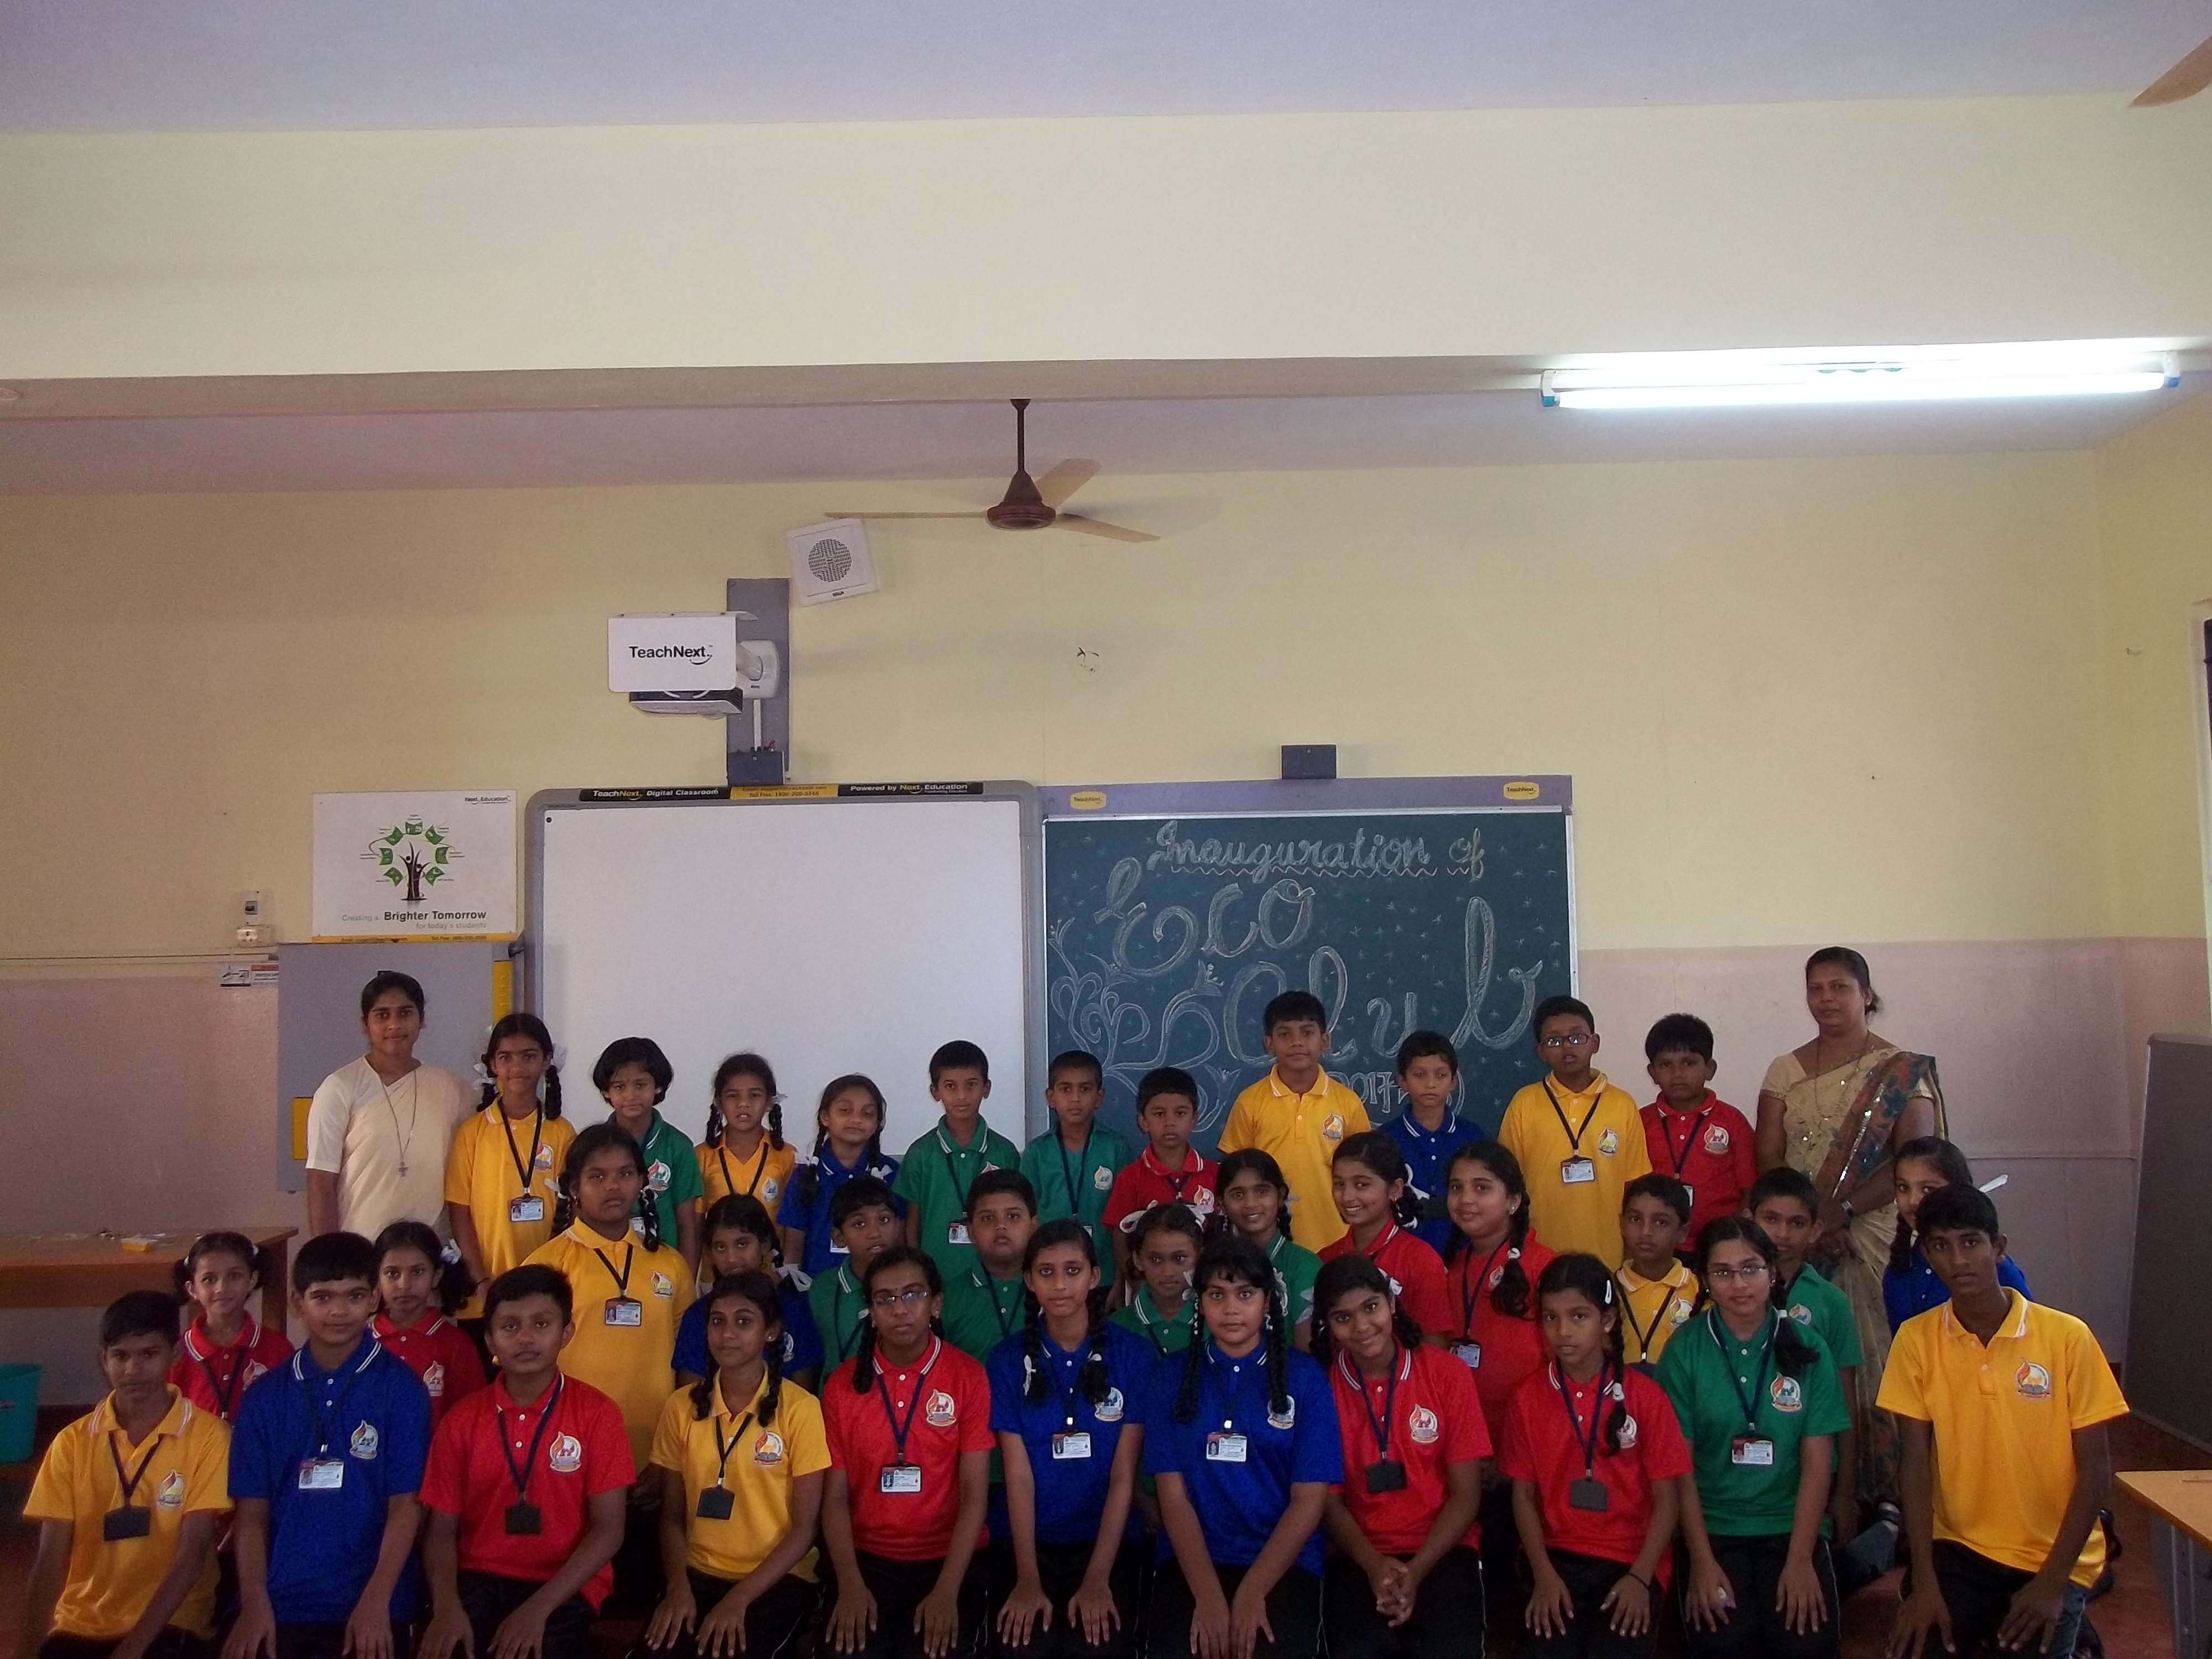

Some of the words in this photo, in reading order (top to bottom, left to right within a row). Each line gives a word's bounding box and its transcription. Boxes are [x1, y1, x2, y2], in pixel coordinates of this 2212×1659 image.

[628, 645, 707, 659] TeachNext
[1146, 820, 1431, 884] Inauguration
[1449, 827, 1485, 883] of
[384, 911, 429, 922] Brighter
[432, 911, 487, 920] Tomorrow
